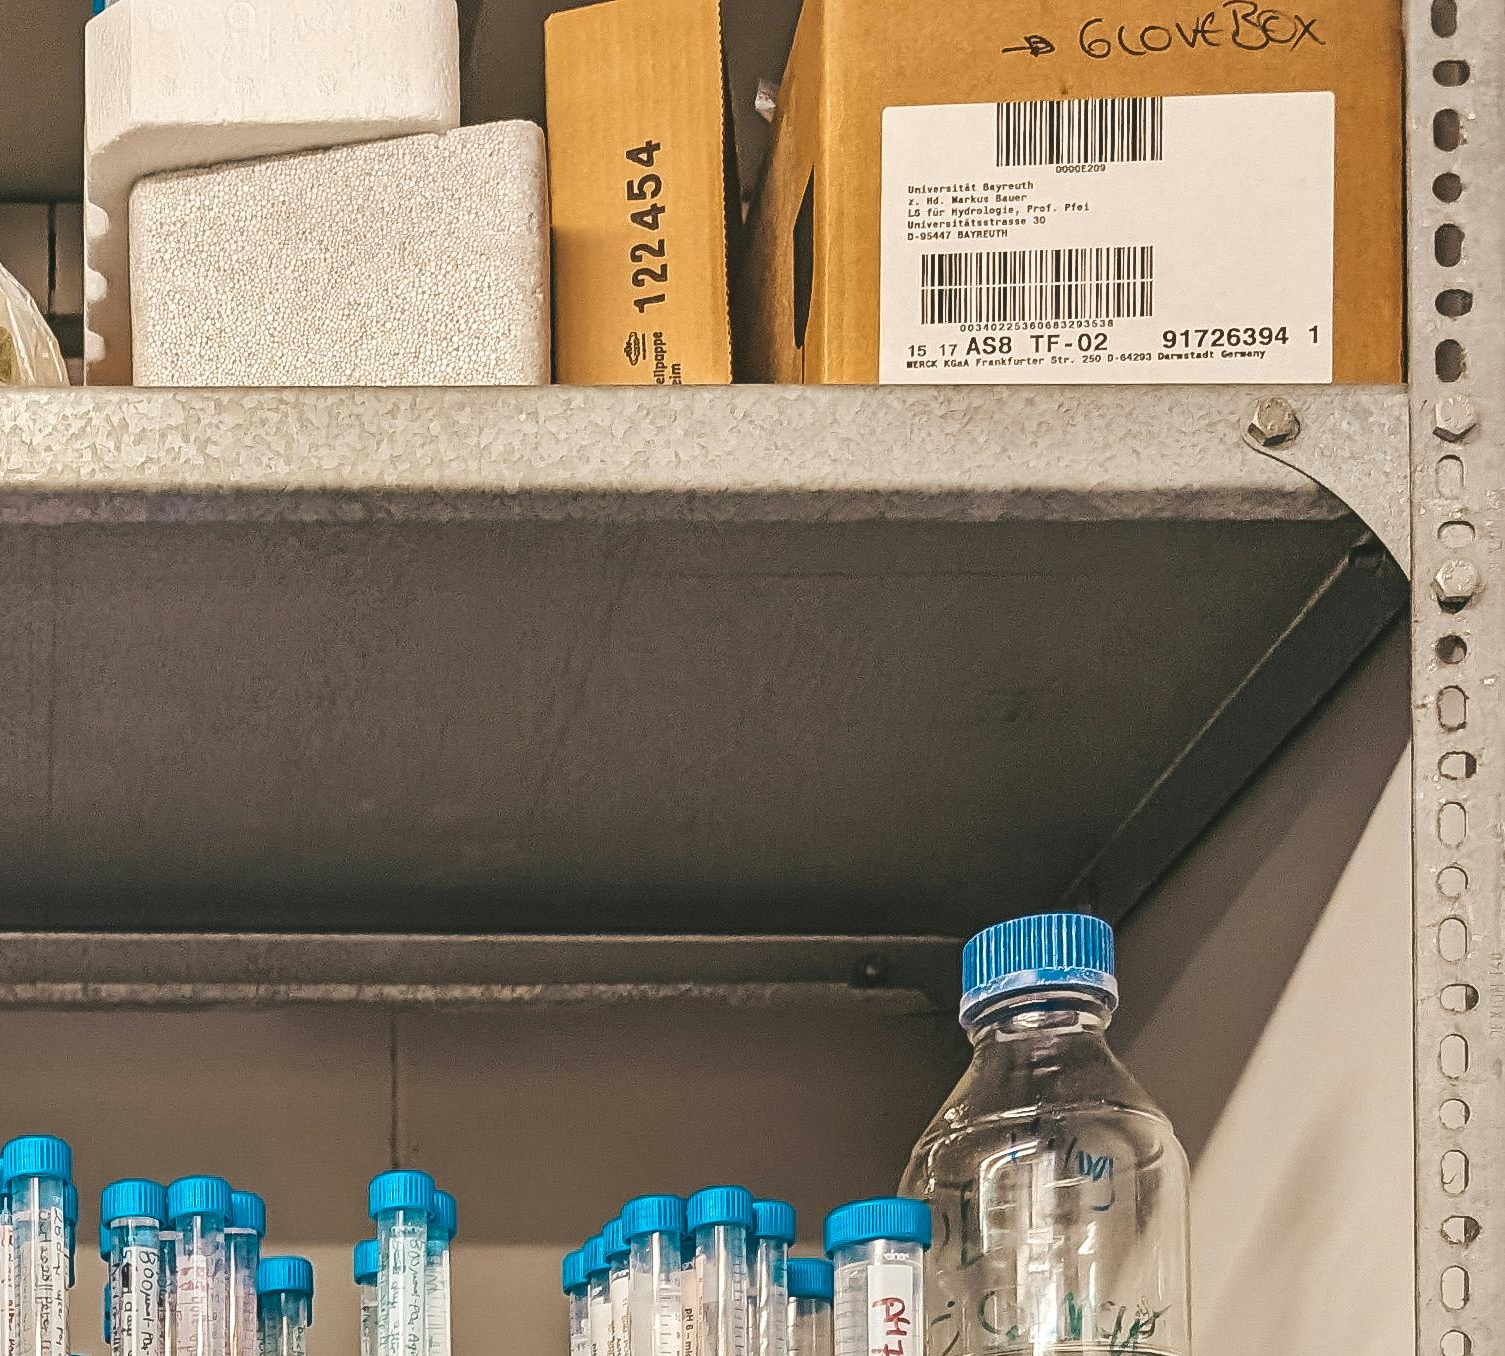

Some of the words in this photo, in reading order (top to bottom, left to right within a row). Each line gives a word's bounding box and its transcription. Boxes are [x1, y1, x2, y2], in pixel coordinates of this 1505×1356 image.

[908, 183, 977, 195] Universität
[983, 181, 1034, 192] Bayreuth
[926, 196, 945, 206] Hd.
[951, 194, 990, 204] Markus
[995, 192, 1028, 203] Bauer
[907, 208, 921, 218] LS
[927, 207, 946, 217] für
[951, 205, 1020, 219] Hydrologie,
[1026, 203, 1058, 215] Prof.
[625, 140, 668, 314] 122454
[907, 218, 1027, 231] Universitätsstrasse
[1033, 216, 1046, 226] 30
[907, 231, 951, 241] D-95447
[957, 229, 1008, 240] BAYREUTH
[908, 345, 927, 357] 15
[939, 343, 957, 356] 17
[1030, 333, 1108, 353] TF-02
[1162, 327, 1289, 349] 91726394
[1308, 325, 1320, 344] 1
[653, 331, 668, 384] ellpappe
[906, 359, 938, 369] MERCK
[944, 358, 970, 369] KGaA
[975, 355, 1045, 368] Frankfurter
[1051, 355, 1075, 366] Str.
[1082, 354, 1102, 364] 250
[1107, 352, 1152, 363] D-64293
[1157, 350, 1215, 361] Darmstadt
[1220, 348, 1266, 361] Germany
